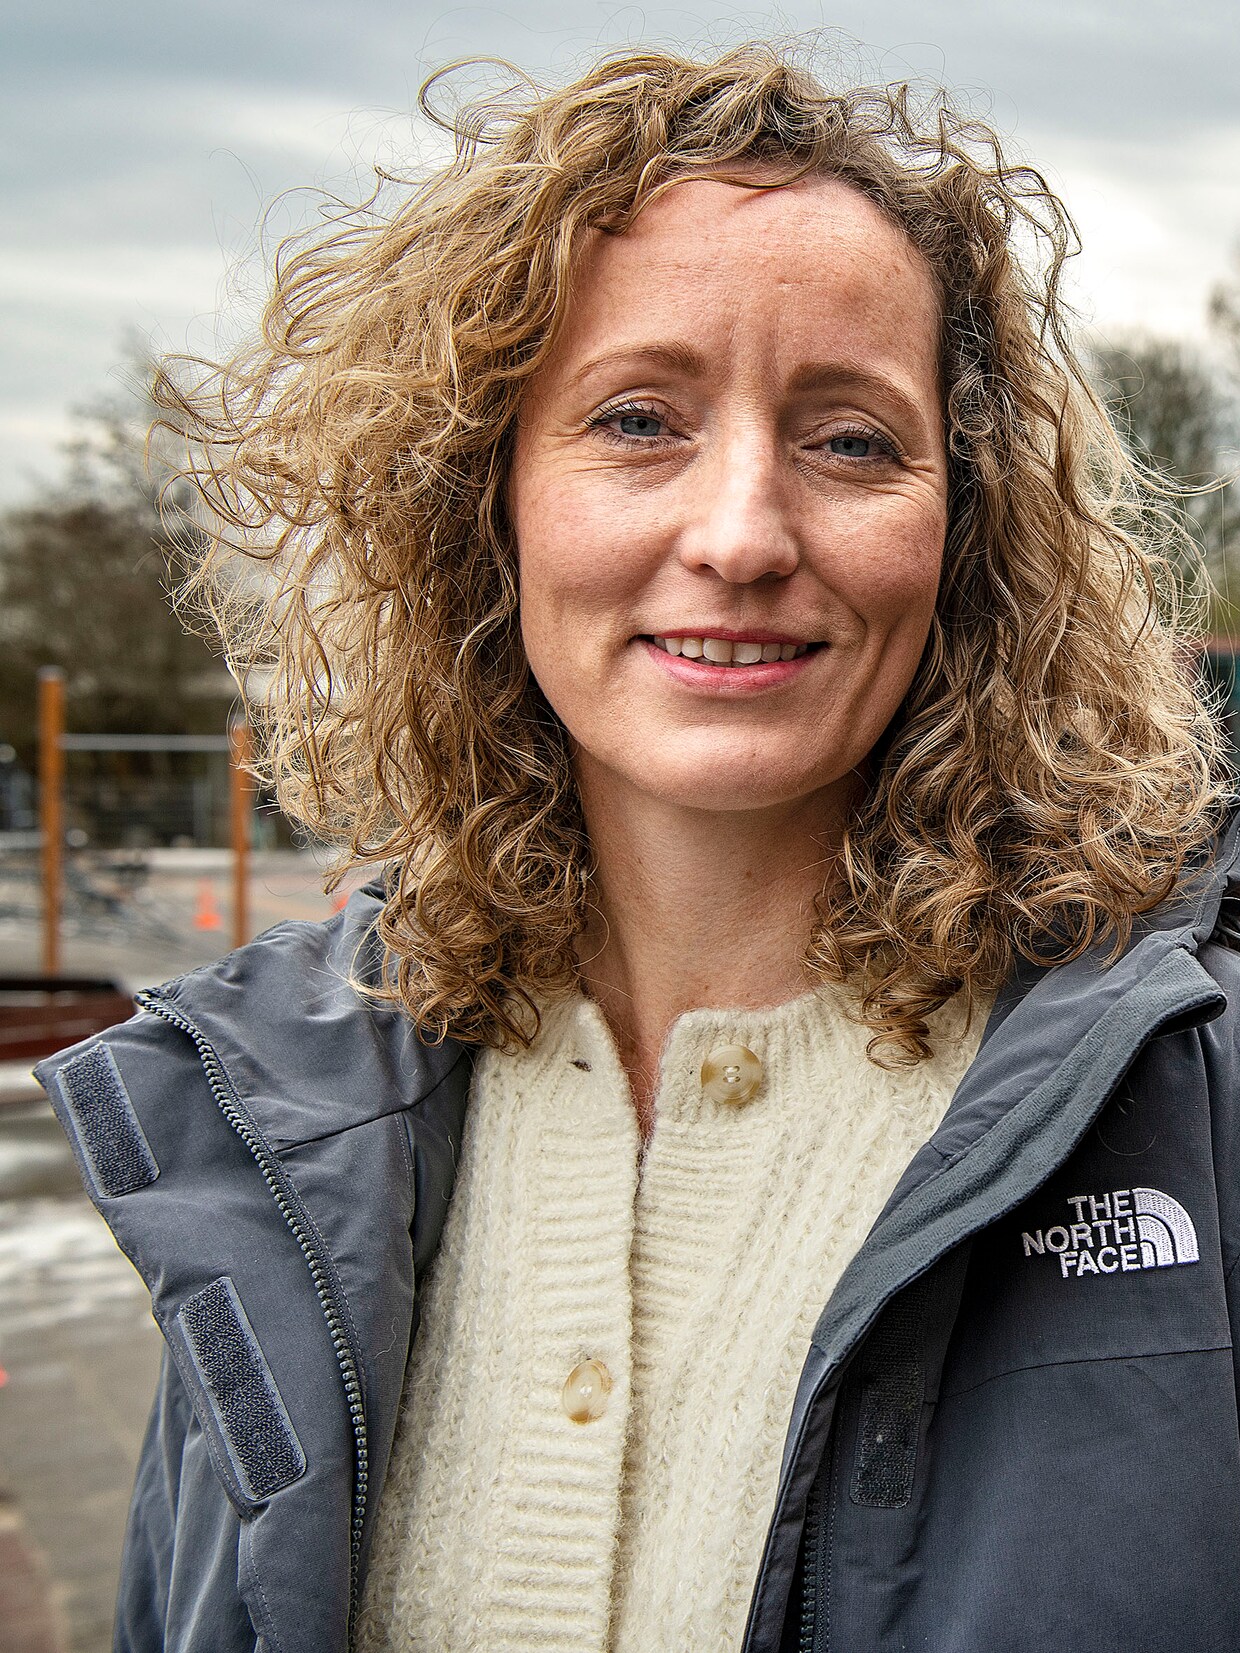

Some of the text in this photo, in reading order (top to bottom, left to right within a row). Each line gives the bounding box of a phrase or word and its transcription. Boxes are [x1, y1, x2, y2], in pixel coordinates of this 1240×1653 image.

[1067, 1189, 1133, 1222] THE
[1021, 1216, 1137, 1257] NORTH
[1059, 1244, 1141, 1279] FACE
